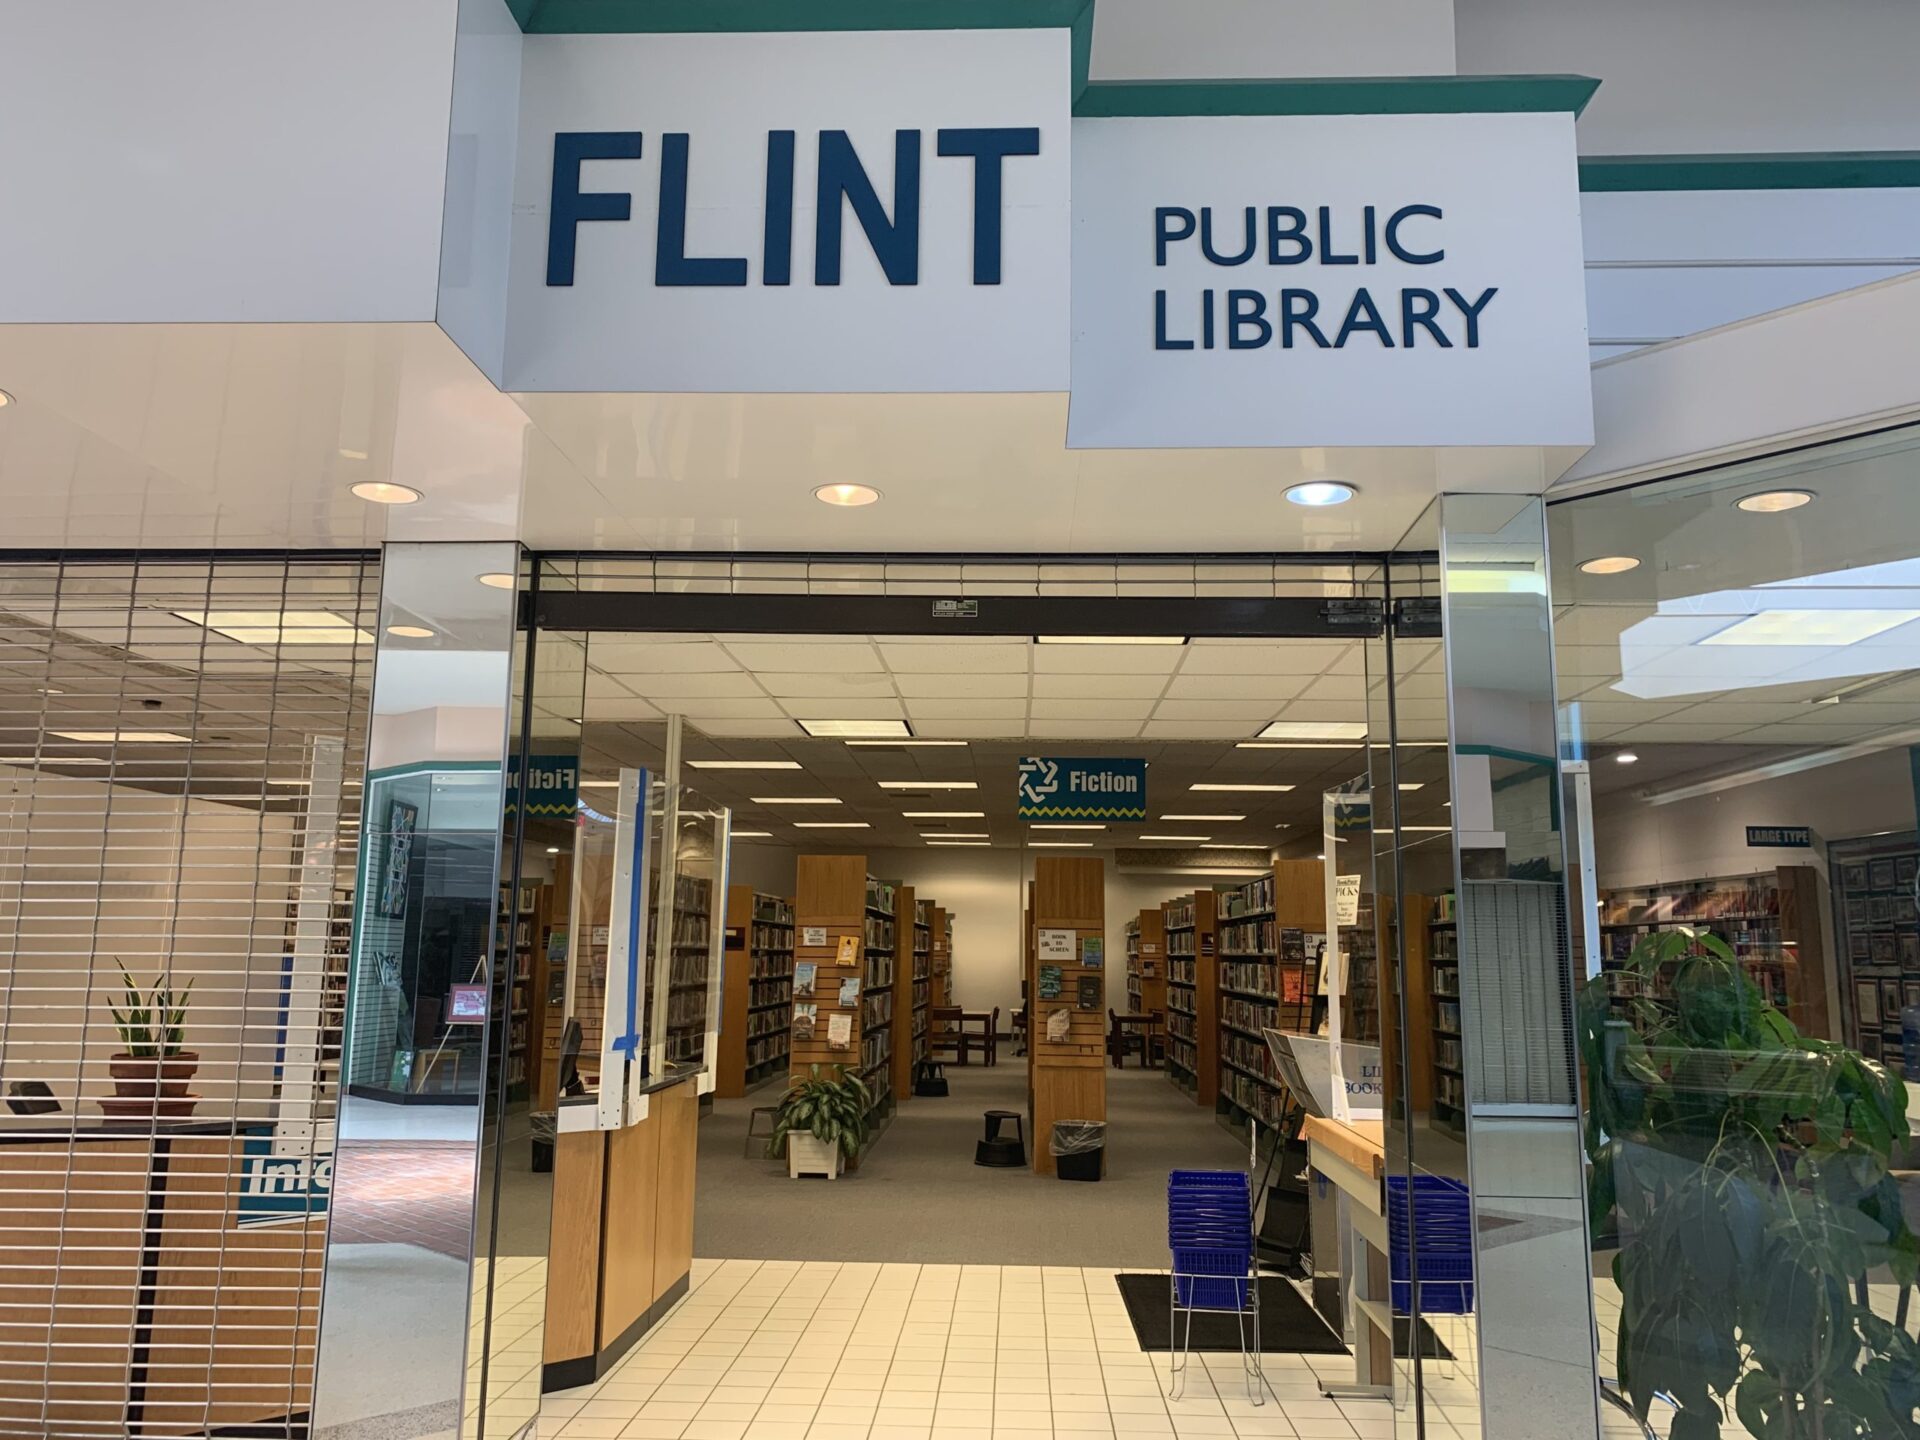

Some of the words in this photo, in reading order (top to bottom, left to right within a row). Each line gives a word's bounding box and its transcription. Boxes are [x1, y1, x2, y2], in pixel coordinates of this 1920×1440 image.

[546, 127, 1040, 288] FLINT
[1154, 204, 1446, 267] PUBLIC
[1154, 287, 1500, 352] LIBRARY
[1069, 771, 1138, 793] Fiction
[1749, 830, 1781, 843] LARGE
[1783, 830, 1809, 843] TYPE
